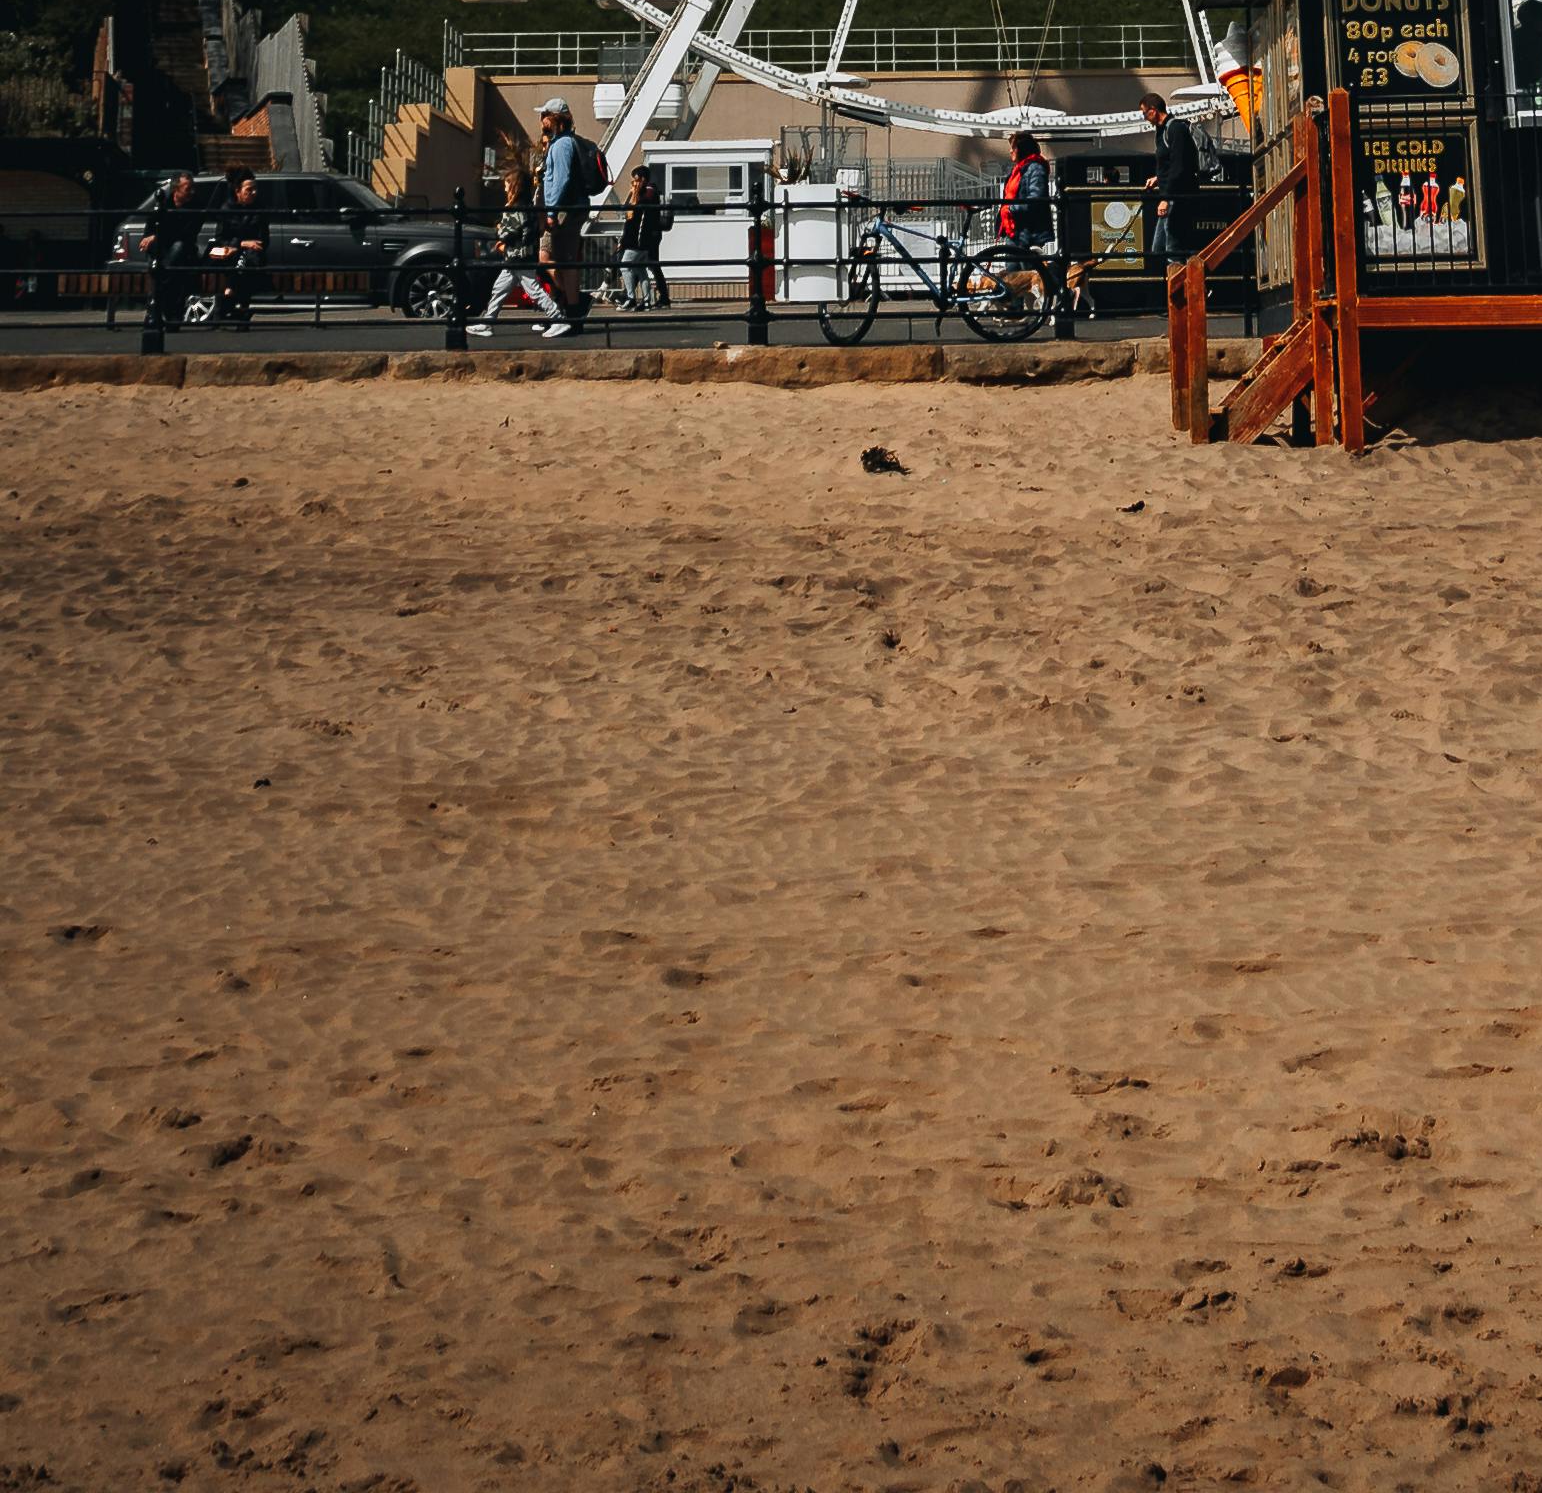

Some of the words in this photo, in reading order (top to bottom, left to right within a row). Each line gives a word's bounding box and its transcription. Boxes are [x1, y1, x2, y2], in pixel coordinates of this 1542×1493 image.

[1346, 20, 1394, 43] 80p
[1400, 18, 1449, 38] each
[1368, 49, 1399, 63] FOR
[1360, 68, 1389, 87] £3
[1364, 141, 1390, 156] ICE
[1396, 140, 1445, 156] COLD
[1374, 157, 1437, 174] DRINKS
